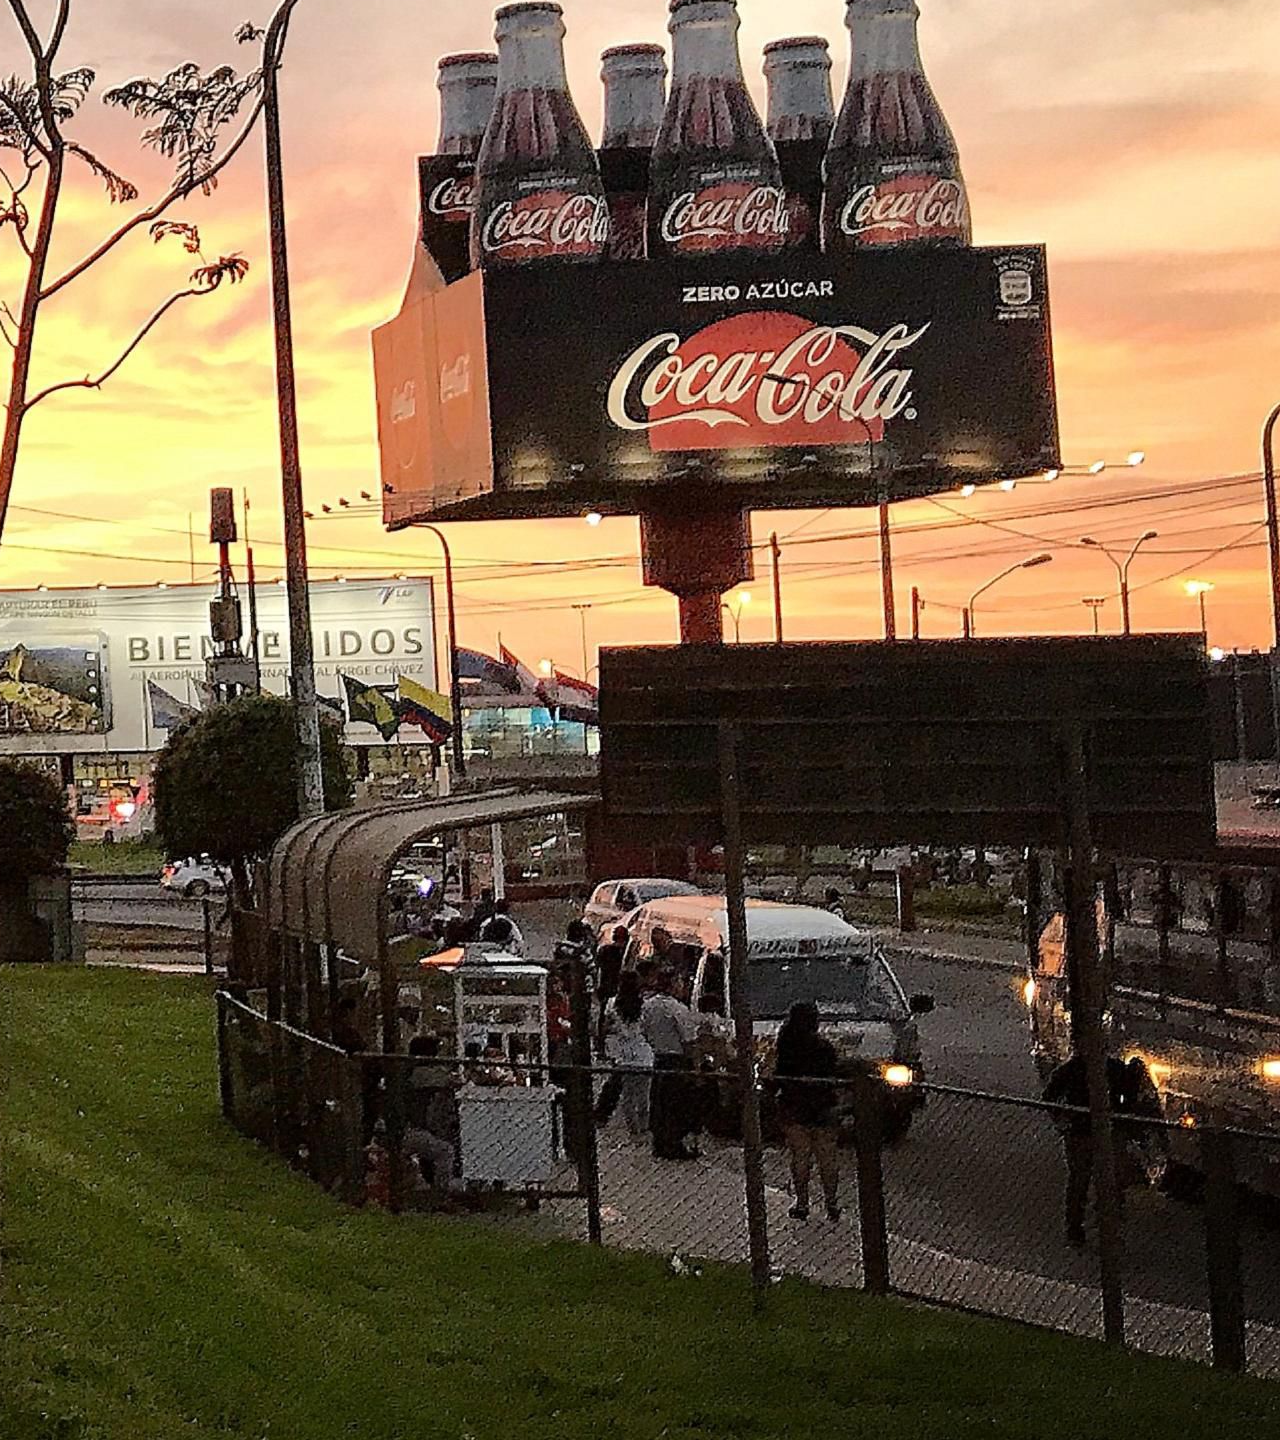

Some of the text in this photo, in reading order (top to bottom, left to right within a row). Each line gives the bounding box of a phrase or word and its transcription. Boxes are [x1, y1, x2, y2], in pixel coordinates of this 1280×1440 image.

[841, 178, 964, 235] Coca-Col
[682, 278, 834, 302] ZERO AZÚCAR
[607, 321, 931, 430] Coca-Cola
[128, 628, 423, 661] BIENEIDOS
[149, 669, 204, 681] AEROPUE
